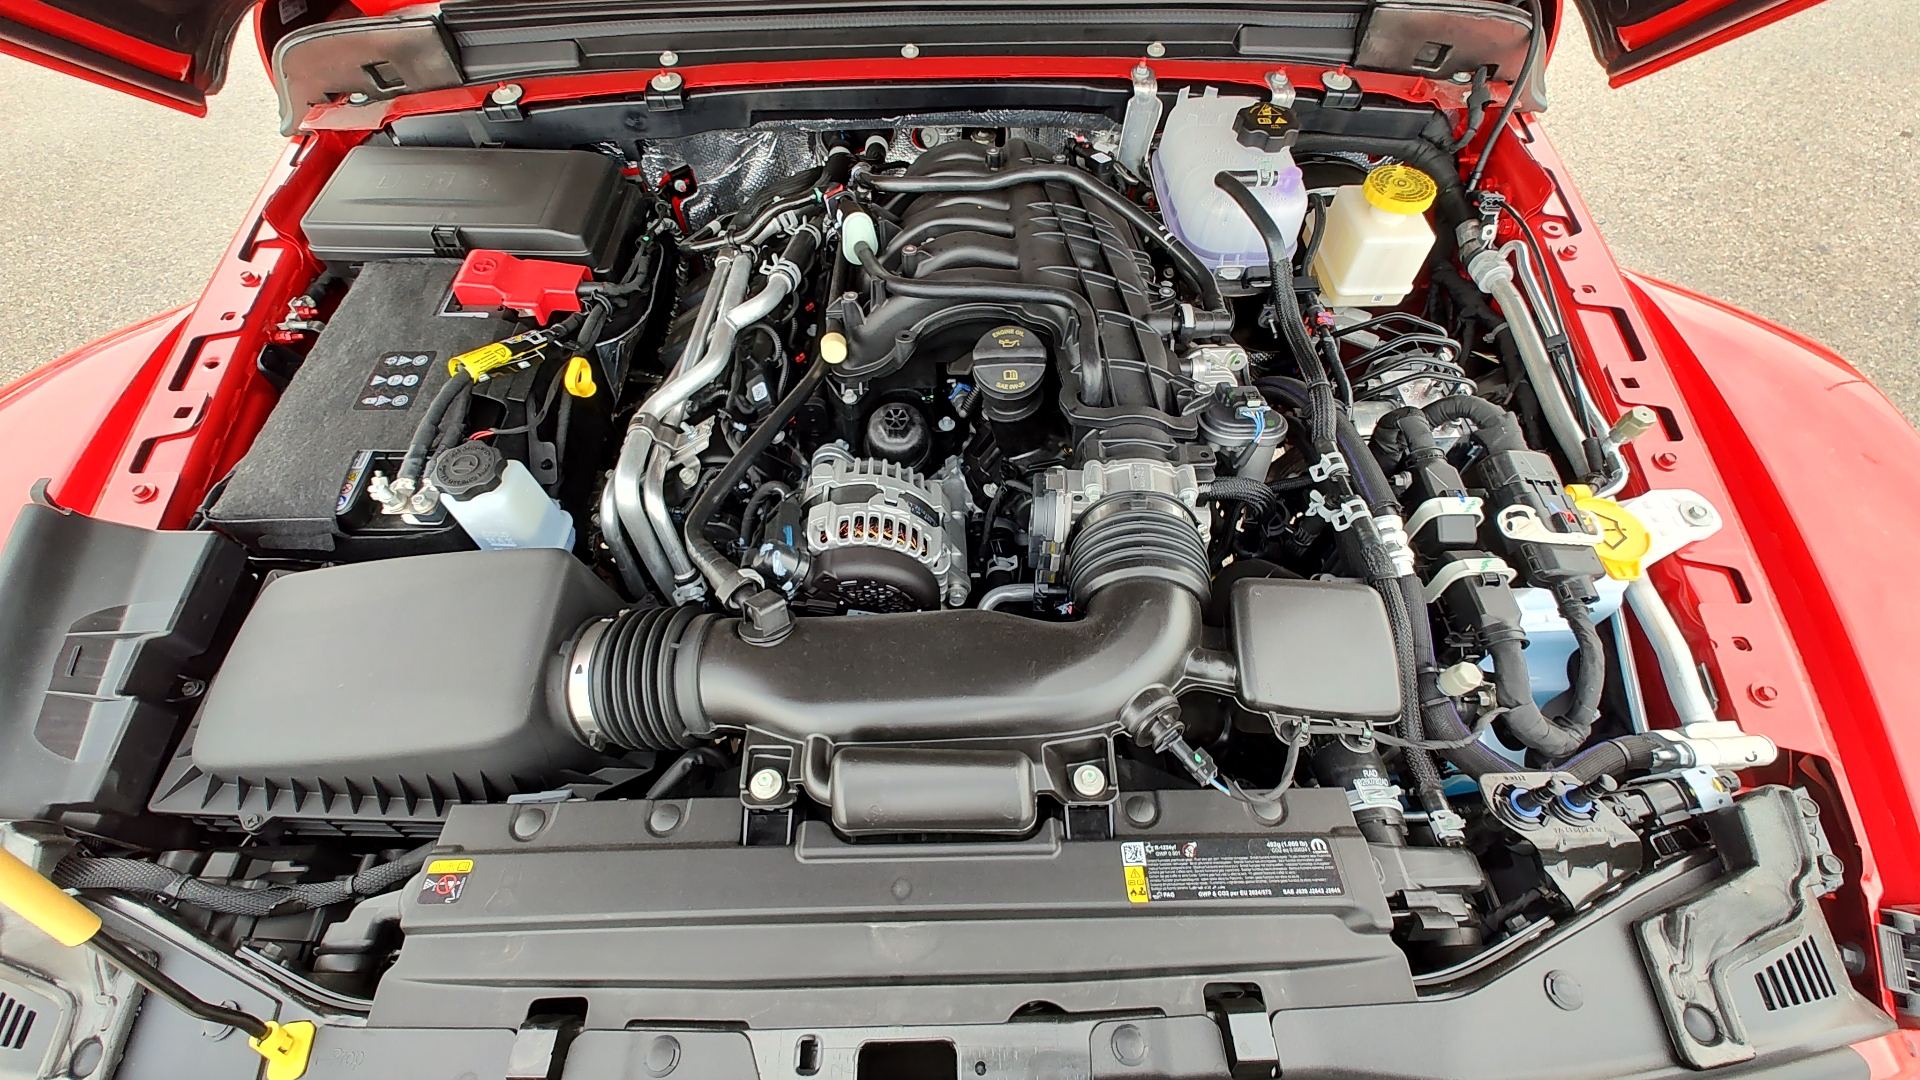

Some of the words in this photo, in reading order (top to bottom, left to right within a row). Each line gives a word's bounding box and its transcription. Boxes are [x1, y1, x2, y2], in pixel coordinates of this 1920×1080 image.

[991, 328, 1015, 338] ENGINE
[1015, 329, 1025, 338] OIL
[995, 381, 1008, 390] SAE
[1009, 381, 1026, 390] 0W-20
[1362, 769, 1378, 778] RAD
[1197, 890, 1212, 898] GWP
[1229, 890, 1239, 898] per
[1282, 888, 1296, 896] SAE
